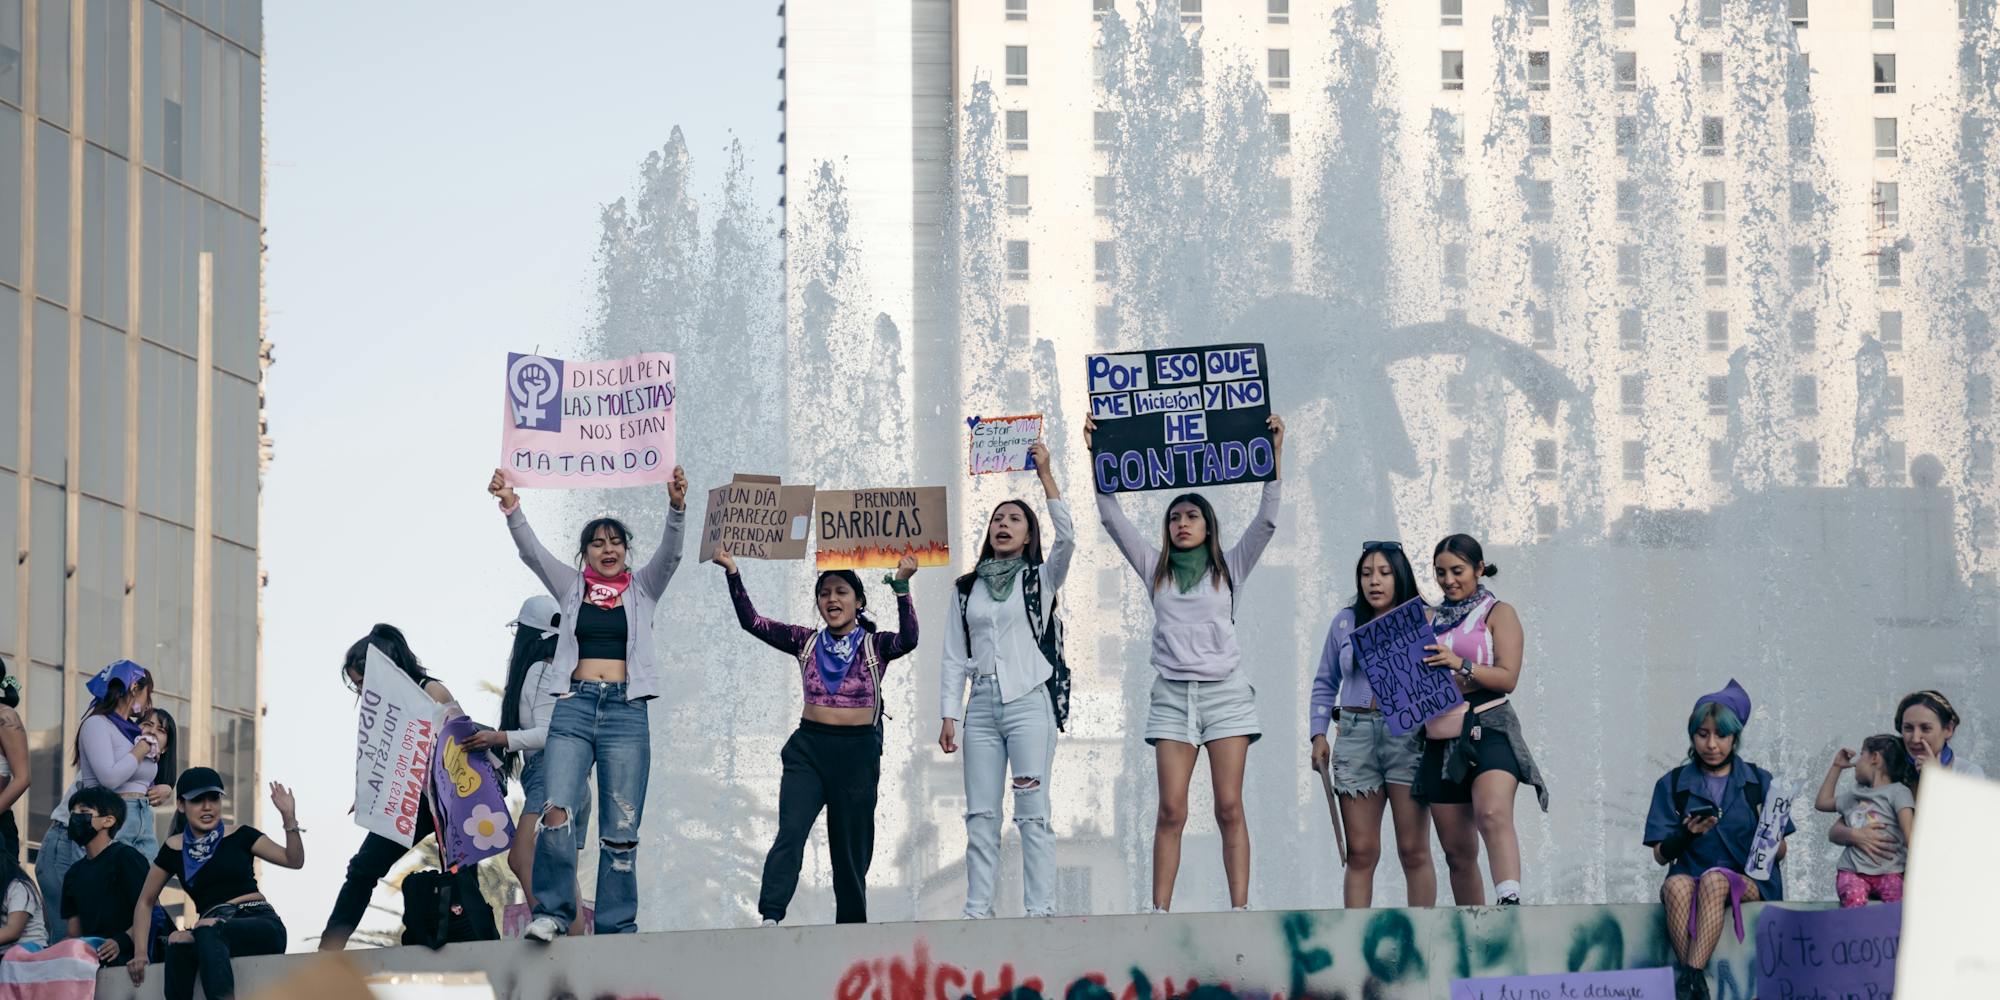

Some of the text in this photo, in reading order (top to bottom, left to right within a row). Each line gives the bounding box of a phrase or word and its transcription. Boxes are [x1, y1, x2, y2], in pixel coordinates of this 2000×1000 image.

[572, 359, 671, 388] DISCULPEN
[1088, 348, 1257, 392] Por ESO QUE
[564, 395, 592, 417] LAS
[1092, 393, 1129, 416] ME
[1204, 385, 1220, 408] Y
[1226, 382, 1262, 407] NO
[580, 416, 666, 440] NOS ESTAN
[975, 419, 1036, 436] Estar VIVA
[1167, 413, 1205, 442] HE
[516, 450, 658, 473] MATANDO
[1095, 436, 1275, 493] CONTADO
[717, 488, 776, 507] SI UN DÍA
[854, 490, 916, 509] PRENDAN
[709, 507, 787, 527] NO APAREZCO
[821, 508, 923, 540] BARRICAS
[709, 526, 784, 543] NO PRENDAN
[1355, 603, 1422, 653] MARCHO
[1362, 623, 1429, 667] POR QUE
[1364, 645, 1411, 686] ESTOY
[1371, 673, 1402, 699] VIVA
[1381, 670, 1452, 717] SE HASTA
[1399, 686, 1457, 730] CUANDO
[1761, 920, 1790, 977] Si
[1792, 923, 1823, 967] te
